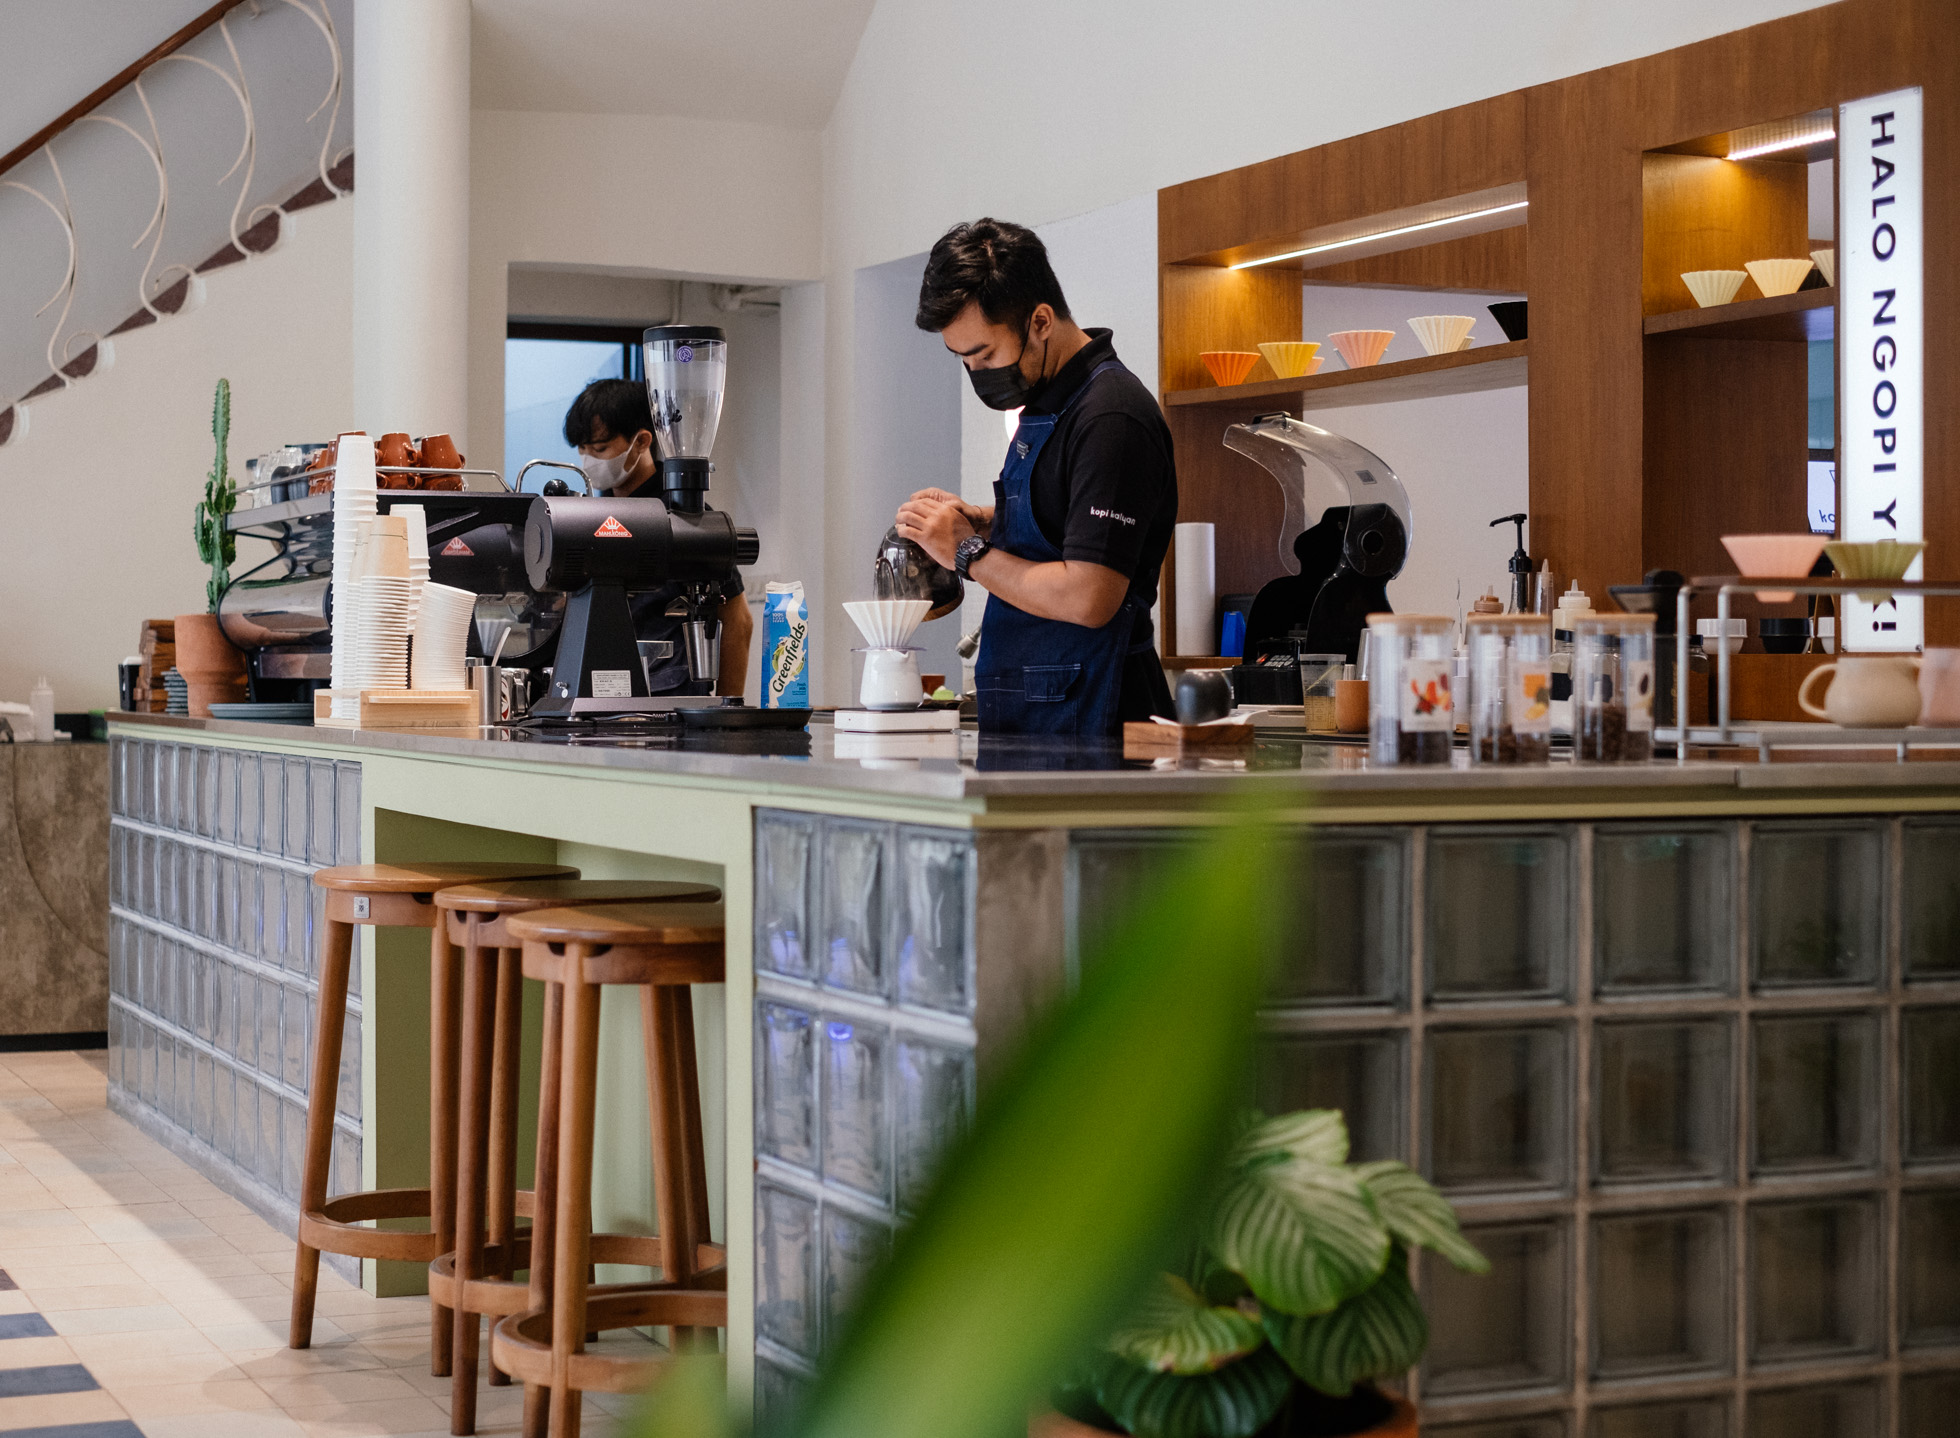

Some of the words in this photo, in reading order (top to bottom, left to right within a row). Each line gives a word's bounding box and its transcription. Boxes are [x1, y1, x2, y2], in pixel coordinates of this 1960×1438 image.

[1871, 111, 1896, 262] HALO
[1872, 288, 1898, 474] NGOPI
[1090, 506, 1109, 518] kopi
[773, 623, 805, 692] Greenfields
